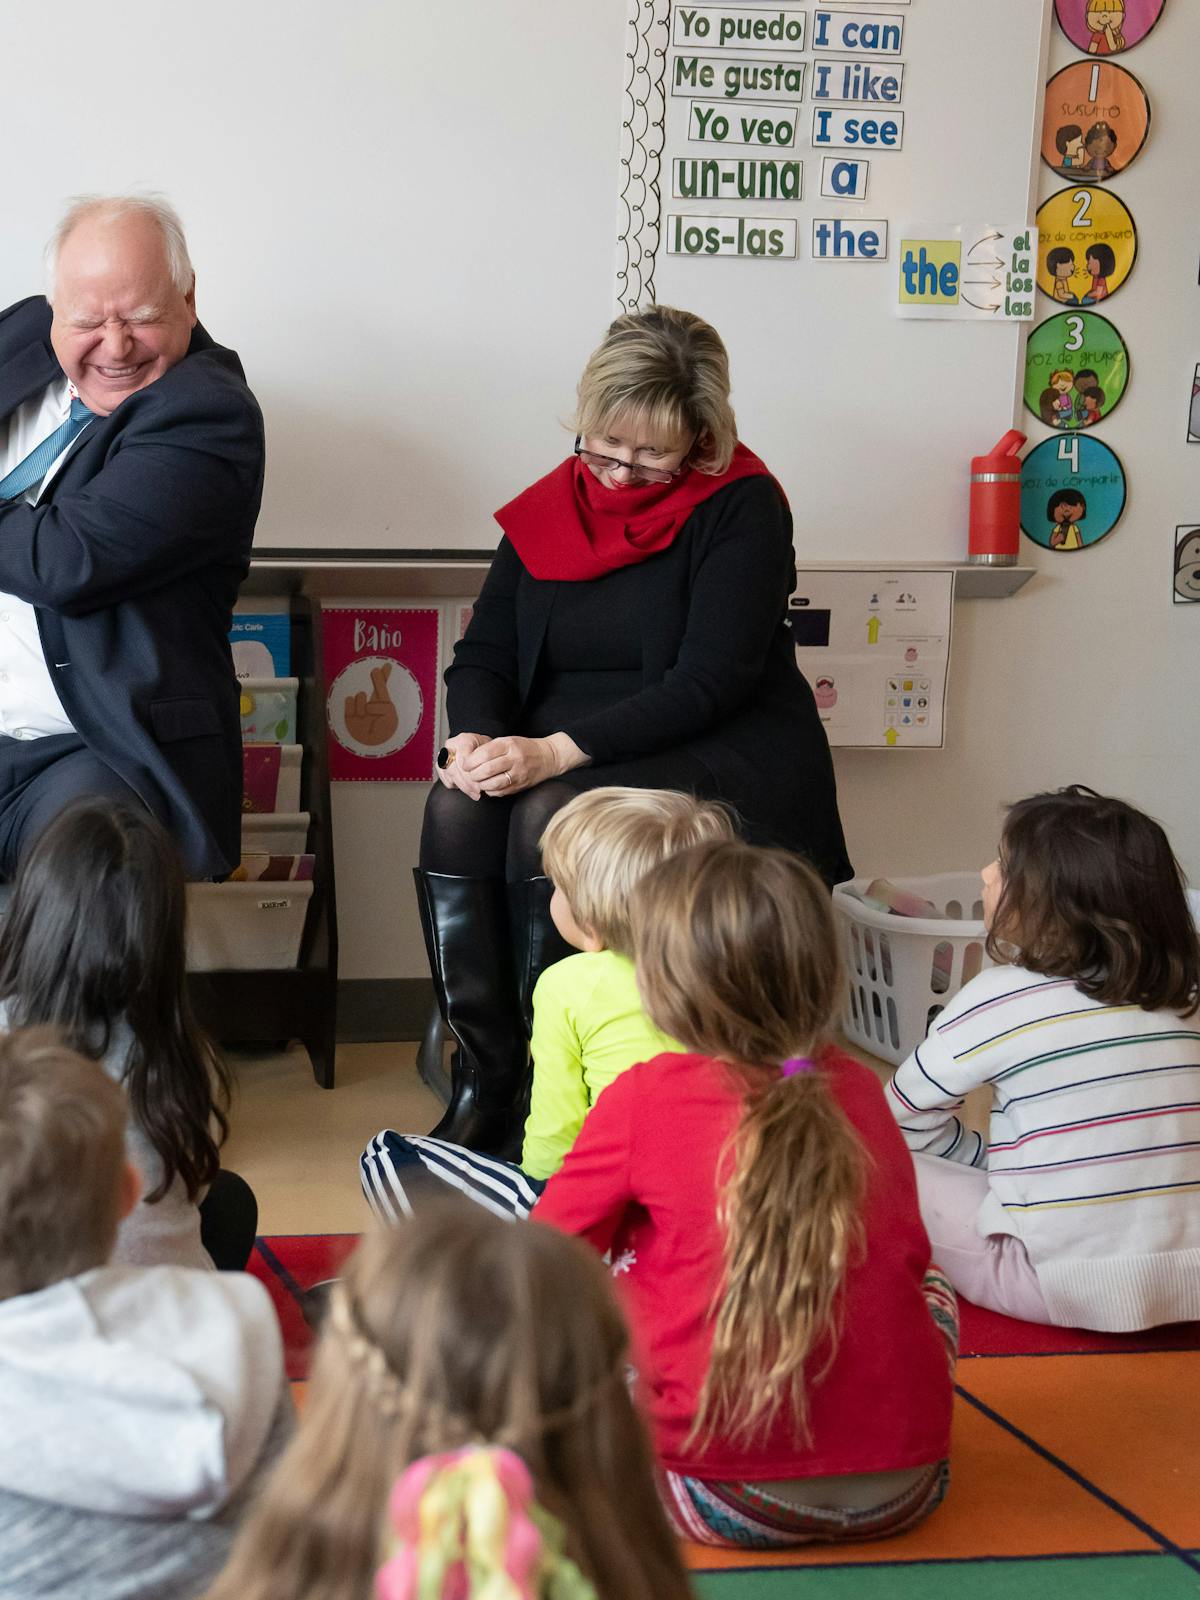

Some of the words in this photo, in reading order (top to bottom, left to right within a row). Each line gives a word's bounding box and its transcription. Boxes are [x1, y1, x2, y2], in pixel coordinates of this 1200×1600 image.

[679, 9, 710, 38] Yo
[719, 12, 802, 46] puedo
[815, 13, 831, 46] I
[841, 21, 901, 50] can
[675, 57, 714, 88] Me
[724, 61, 802, 97] gusta
[815, 65, 831, 98] I
[842, 64, 899, 102] like
[693, 107, 730, 140] Yo
[740, 117, 793, 145] veo
[815, 111, 831, 142] I
[844, 117, 899, 145] see
[678, 160, 800, 199] un-una
[831, 161, 859, 195] a
[1071, 190, 1093, 227] 2
[674, 215, 784, 256] los-las
[816, 219, 880, 257] the
[1012, 231, 1031, 251] el
[901, 247, 960, 297] the
[1011, 253, 1030, 273] la
[1005, 272, 1033, 293] los
[1004, 296, 1032, 317] las
[1064, 315, 1085, 351] 3
[1057, 438, 1079, 473] 4
[353, 618, 402, 652] Baño
